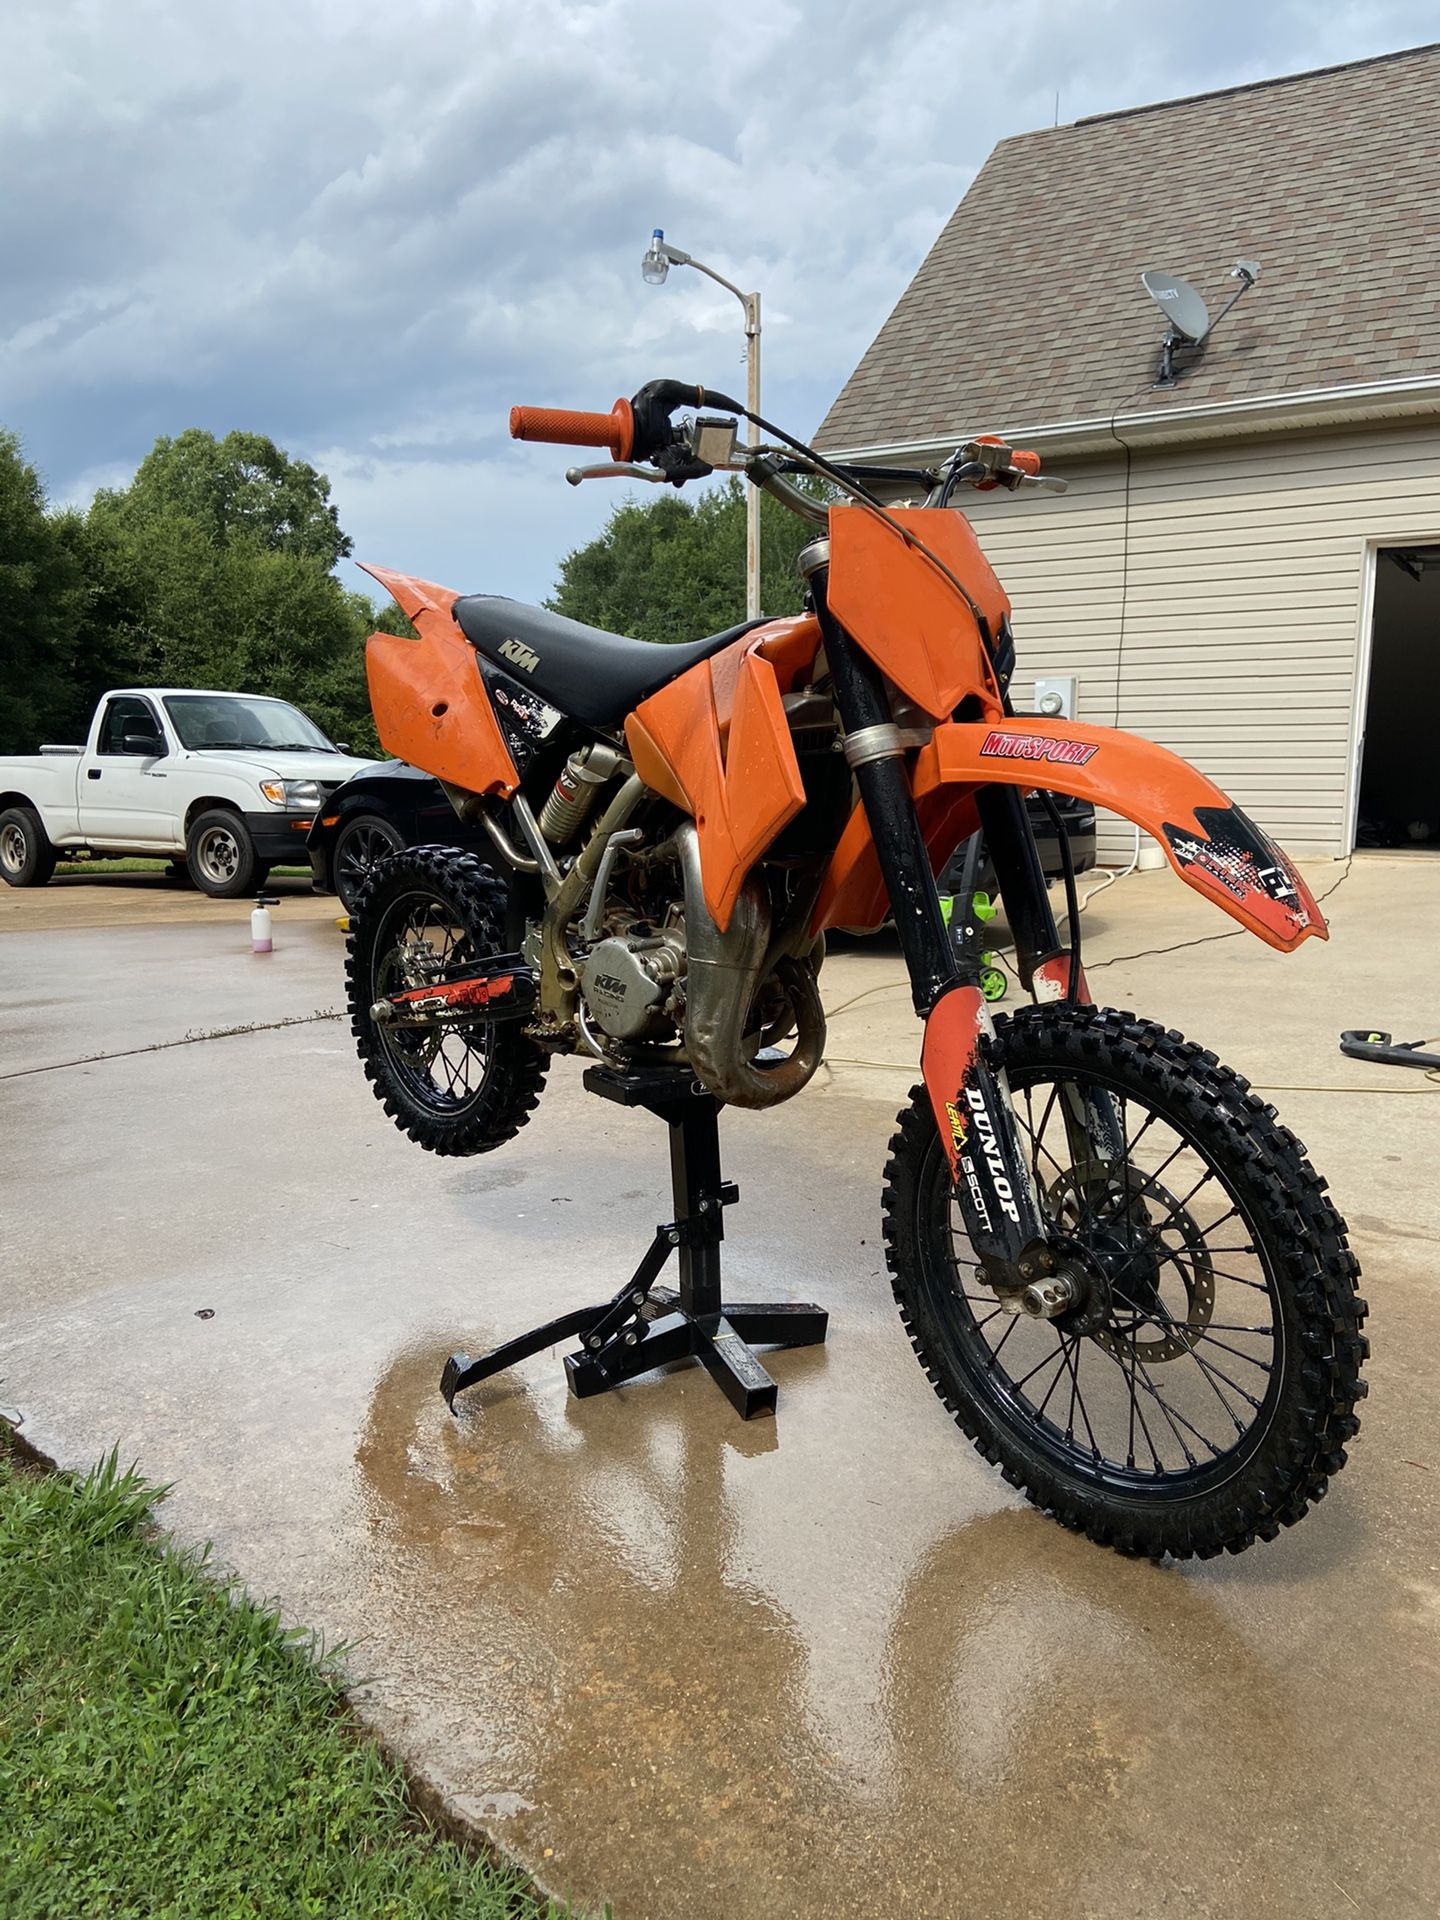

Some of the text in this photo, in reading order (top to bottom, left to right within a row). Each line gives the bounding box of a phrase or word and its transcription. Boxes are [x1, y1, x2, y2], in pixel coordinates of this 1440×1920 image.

[497, 639, 540, 673] KTM
[594, 973, 627, 996] KTM
[965, 1087, 1020, 1223] DUNLOP
[966, 1173, 993, 1233] SCOTT
